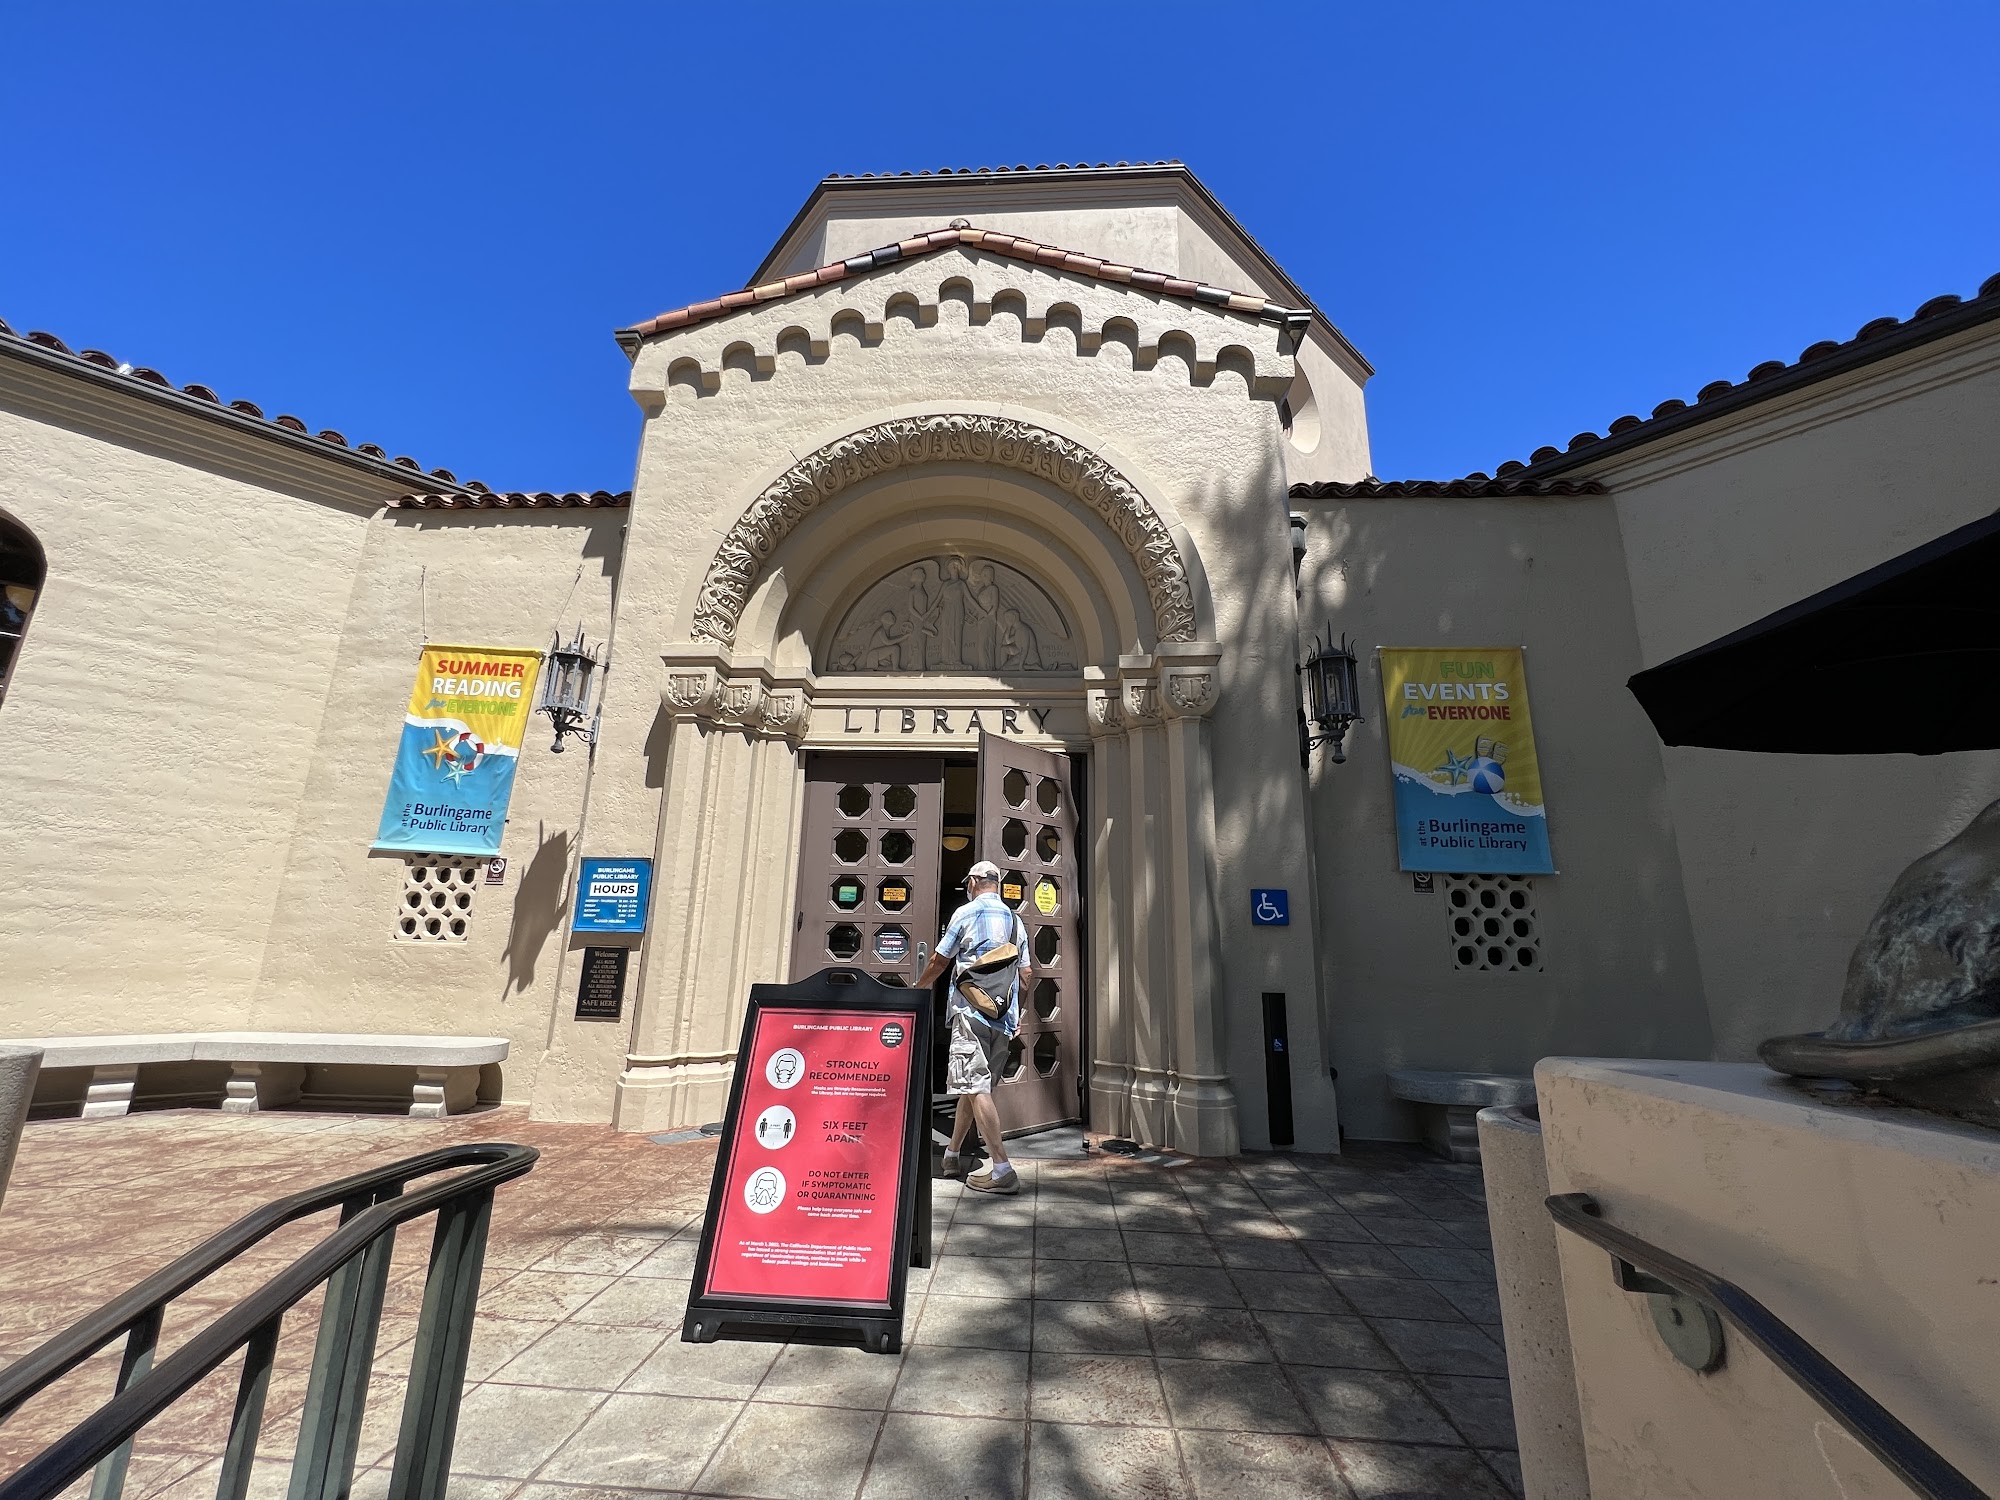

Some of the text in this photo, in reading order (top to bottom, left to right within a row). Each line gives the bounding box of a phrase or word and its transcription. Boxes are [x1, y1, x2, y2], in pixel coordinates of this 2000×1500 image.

[436, 660, 525, 677] SUMMER
[1440, 662, 1494, 678] FUN
[432, 678, 522, 698] READING
[1403, 682, 1509, 700] EVENTS
[425, 698, 518, 716] for EVERYONE
[1401, 704, 1511, 720] for EVERYONE
[844, 708, 1050, 734] LIBRARY
[402, 803, 412, 826] at the
[414, 803, 492, 820] Burlingame
[410, 818, 489, 836] Public Library
[1417, 820, 1426, 846] at the
[1429, 818, 1526, 836] Burlingame
[1430, 836, 1527, 852] Public Library
[594, 885, 635, 894] HOURS
[826, 1060, 880, 1069] STRONGLY
[809, 1072, 891, 1082] RECOMMENDED
[822, 1121, 868, 1130] SIX FEET
[825, 1134, 862, 1143] APART
[811, 1181, 872, 1190] SYMPTOMATIC
[811, 1192, 876, 1200] QUARANTINING
